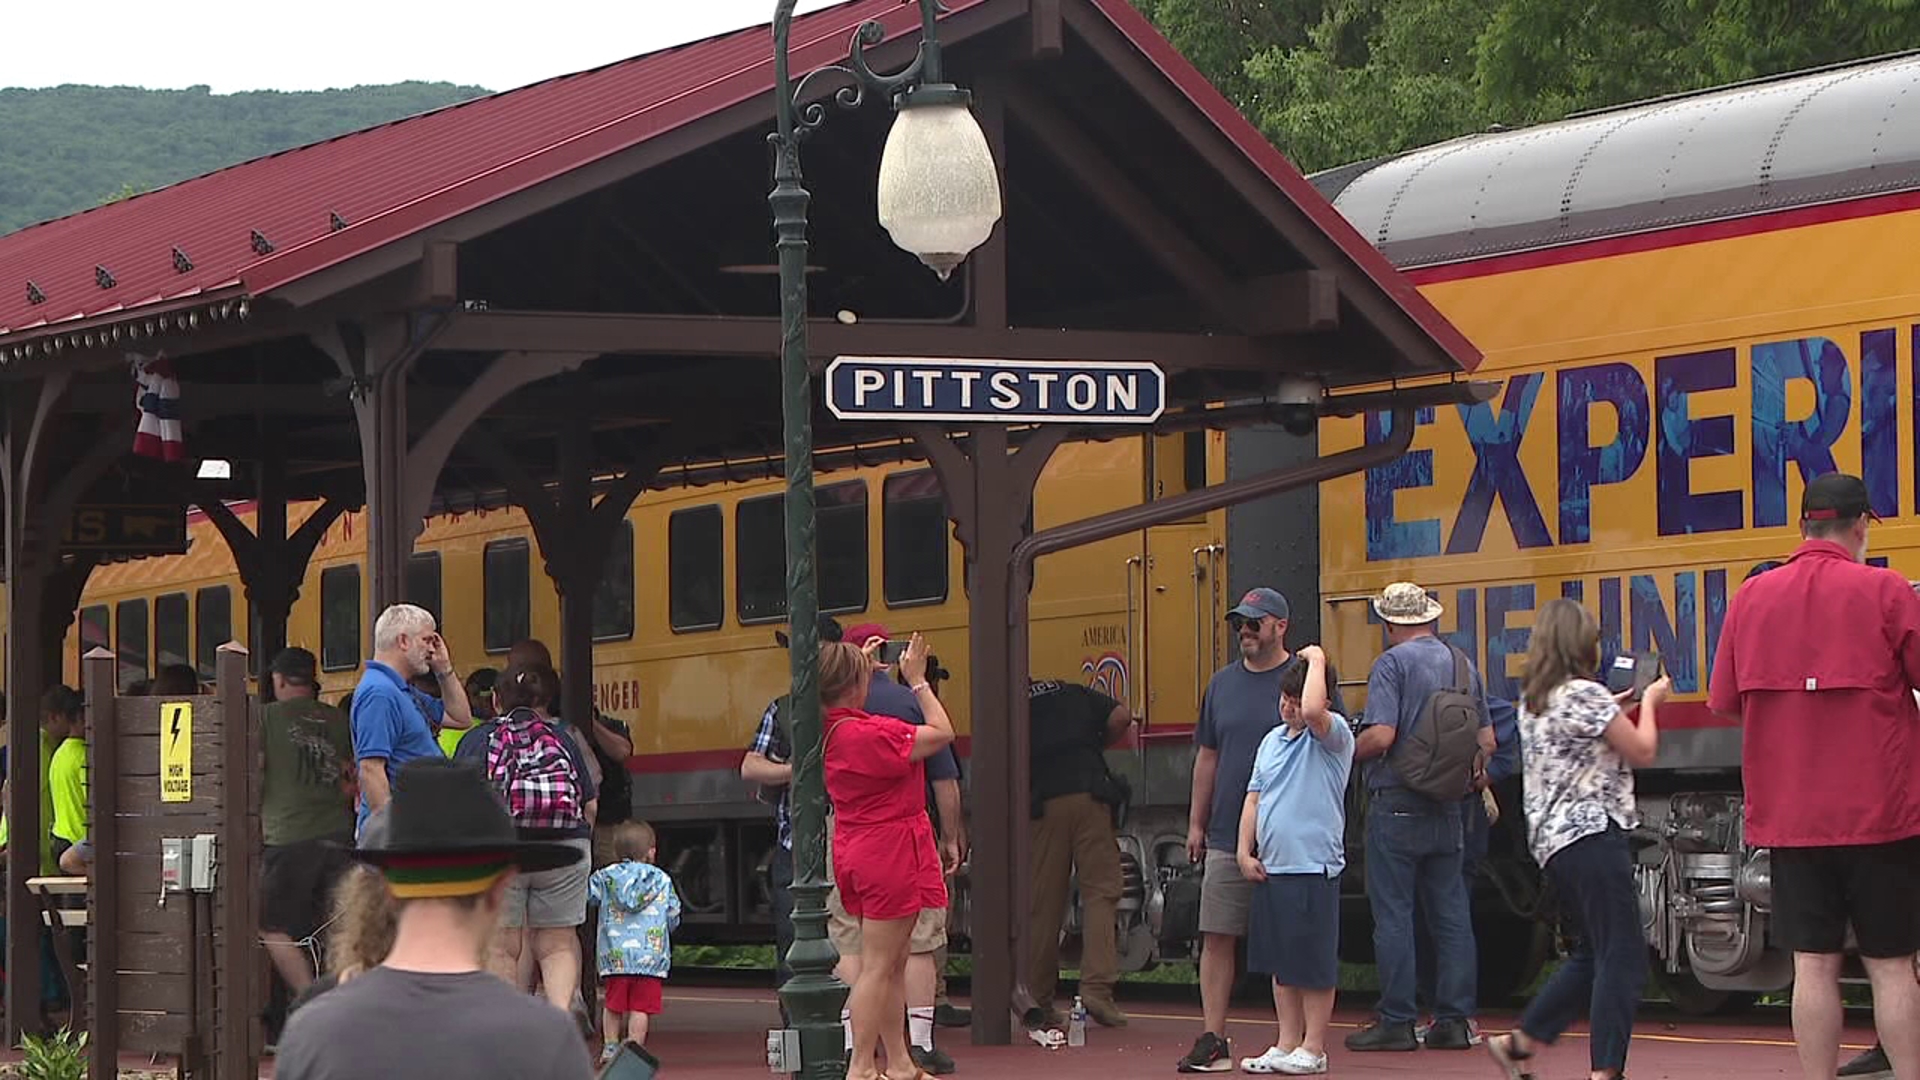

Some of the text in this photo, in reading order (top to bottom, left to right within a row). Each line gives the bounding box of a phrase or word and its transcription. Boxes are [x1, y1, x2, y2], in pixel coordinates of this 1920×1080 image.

[854, 369, 1137, 411] PITTSTON
[1365, 323, 1920, 561] EXPERI
[1082, 625, 1126, 647] AMERICA
[1369, 585, 1536, 693] HE
[594, 680, 640, 711] ENGER
[164, 779, 189, 793] VOLTAGE
[168, 764, 184, 777] HIGH
